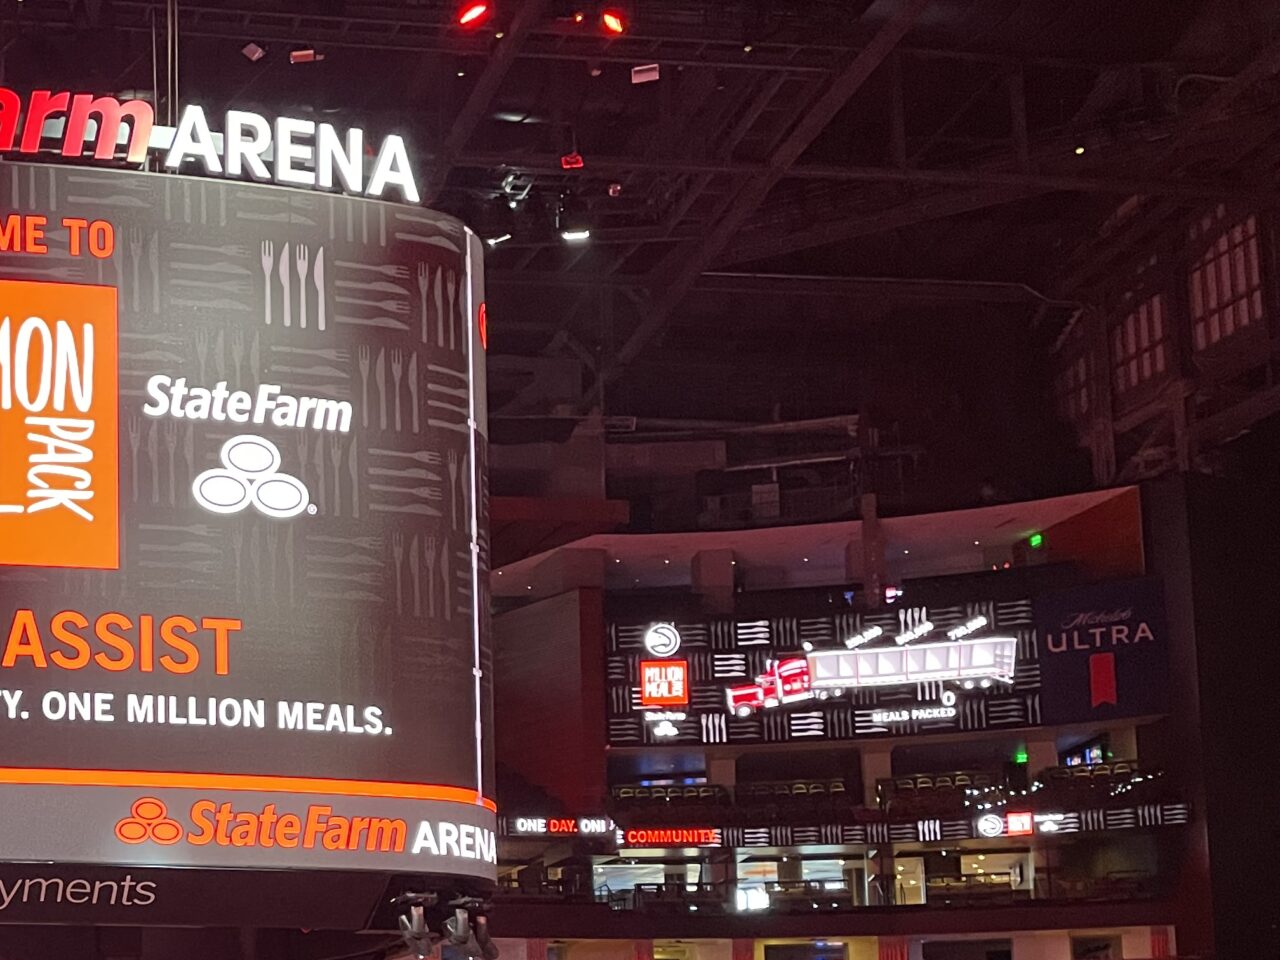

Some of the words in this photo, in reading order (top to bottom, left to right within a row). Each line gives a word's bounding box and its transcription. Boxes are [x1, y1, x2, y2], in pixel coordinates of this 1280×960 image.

[165, 105, 420, 203] ARENA
[63, 218, 115, 259] TO
[24, 416, 94, 522] PACK
[2, 609, 242, 676] ASSIST
[1047, 622, 1154, 653] ULTRA
[41, 691, 114, 723] ONE
[127, 694, 265, 729] MILLION
[278, 701, 393, 735] MEALS.
[872, 708, 910, 723] MEALS
[911, 706, 956, 721] PACKED
[942, 690, 956, 707] 0
[412, 820, 497, 865] ARENA
[517, 818, 546, 833] ONE
[549, 818, 578, 833] DAY.
